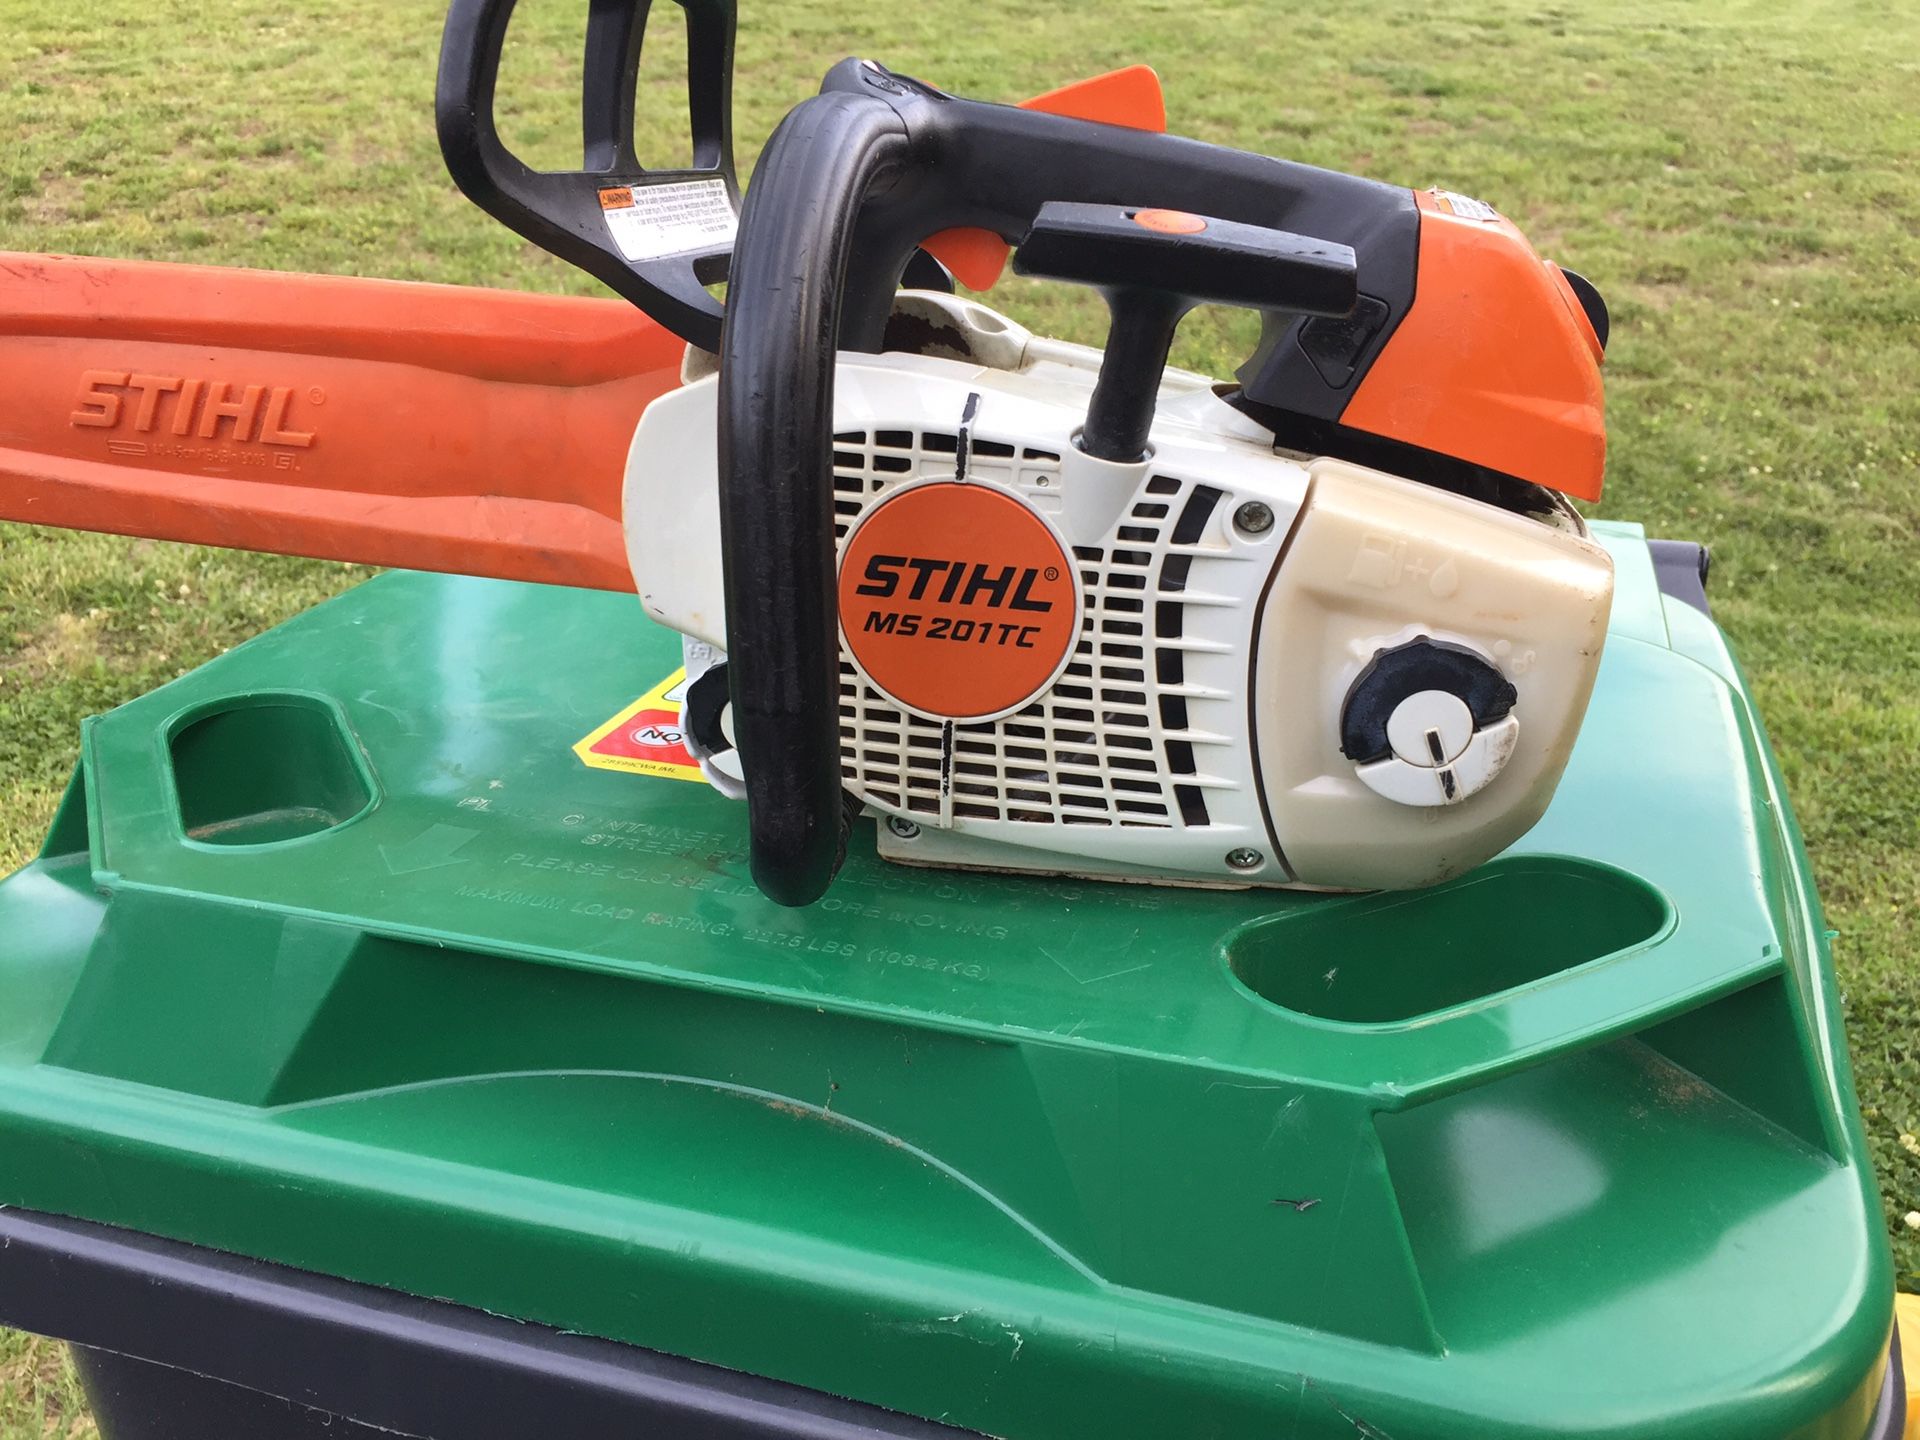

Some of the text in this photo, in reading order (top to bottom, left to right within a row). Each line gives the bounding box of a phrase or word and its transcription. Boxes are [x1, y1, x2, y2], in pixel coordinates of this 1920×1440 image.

[70, 369, 316, 447] STIHL
[856, 554, 1053, 613] STIHL
[863, 611, 1041, 648] MS 201TC
[503, 852, 615, 877] PLEASE
[615, 866, 712, 891] CLOSE
[713, 879, 759, 897] LID
[453, 884, 561, 911] MAXIMUM
[570, 900, 635, 920] LOAD
[641, 911, 736, 937] RATING:
[806, 935, 857, 957] LBS
